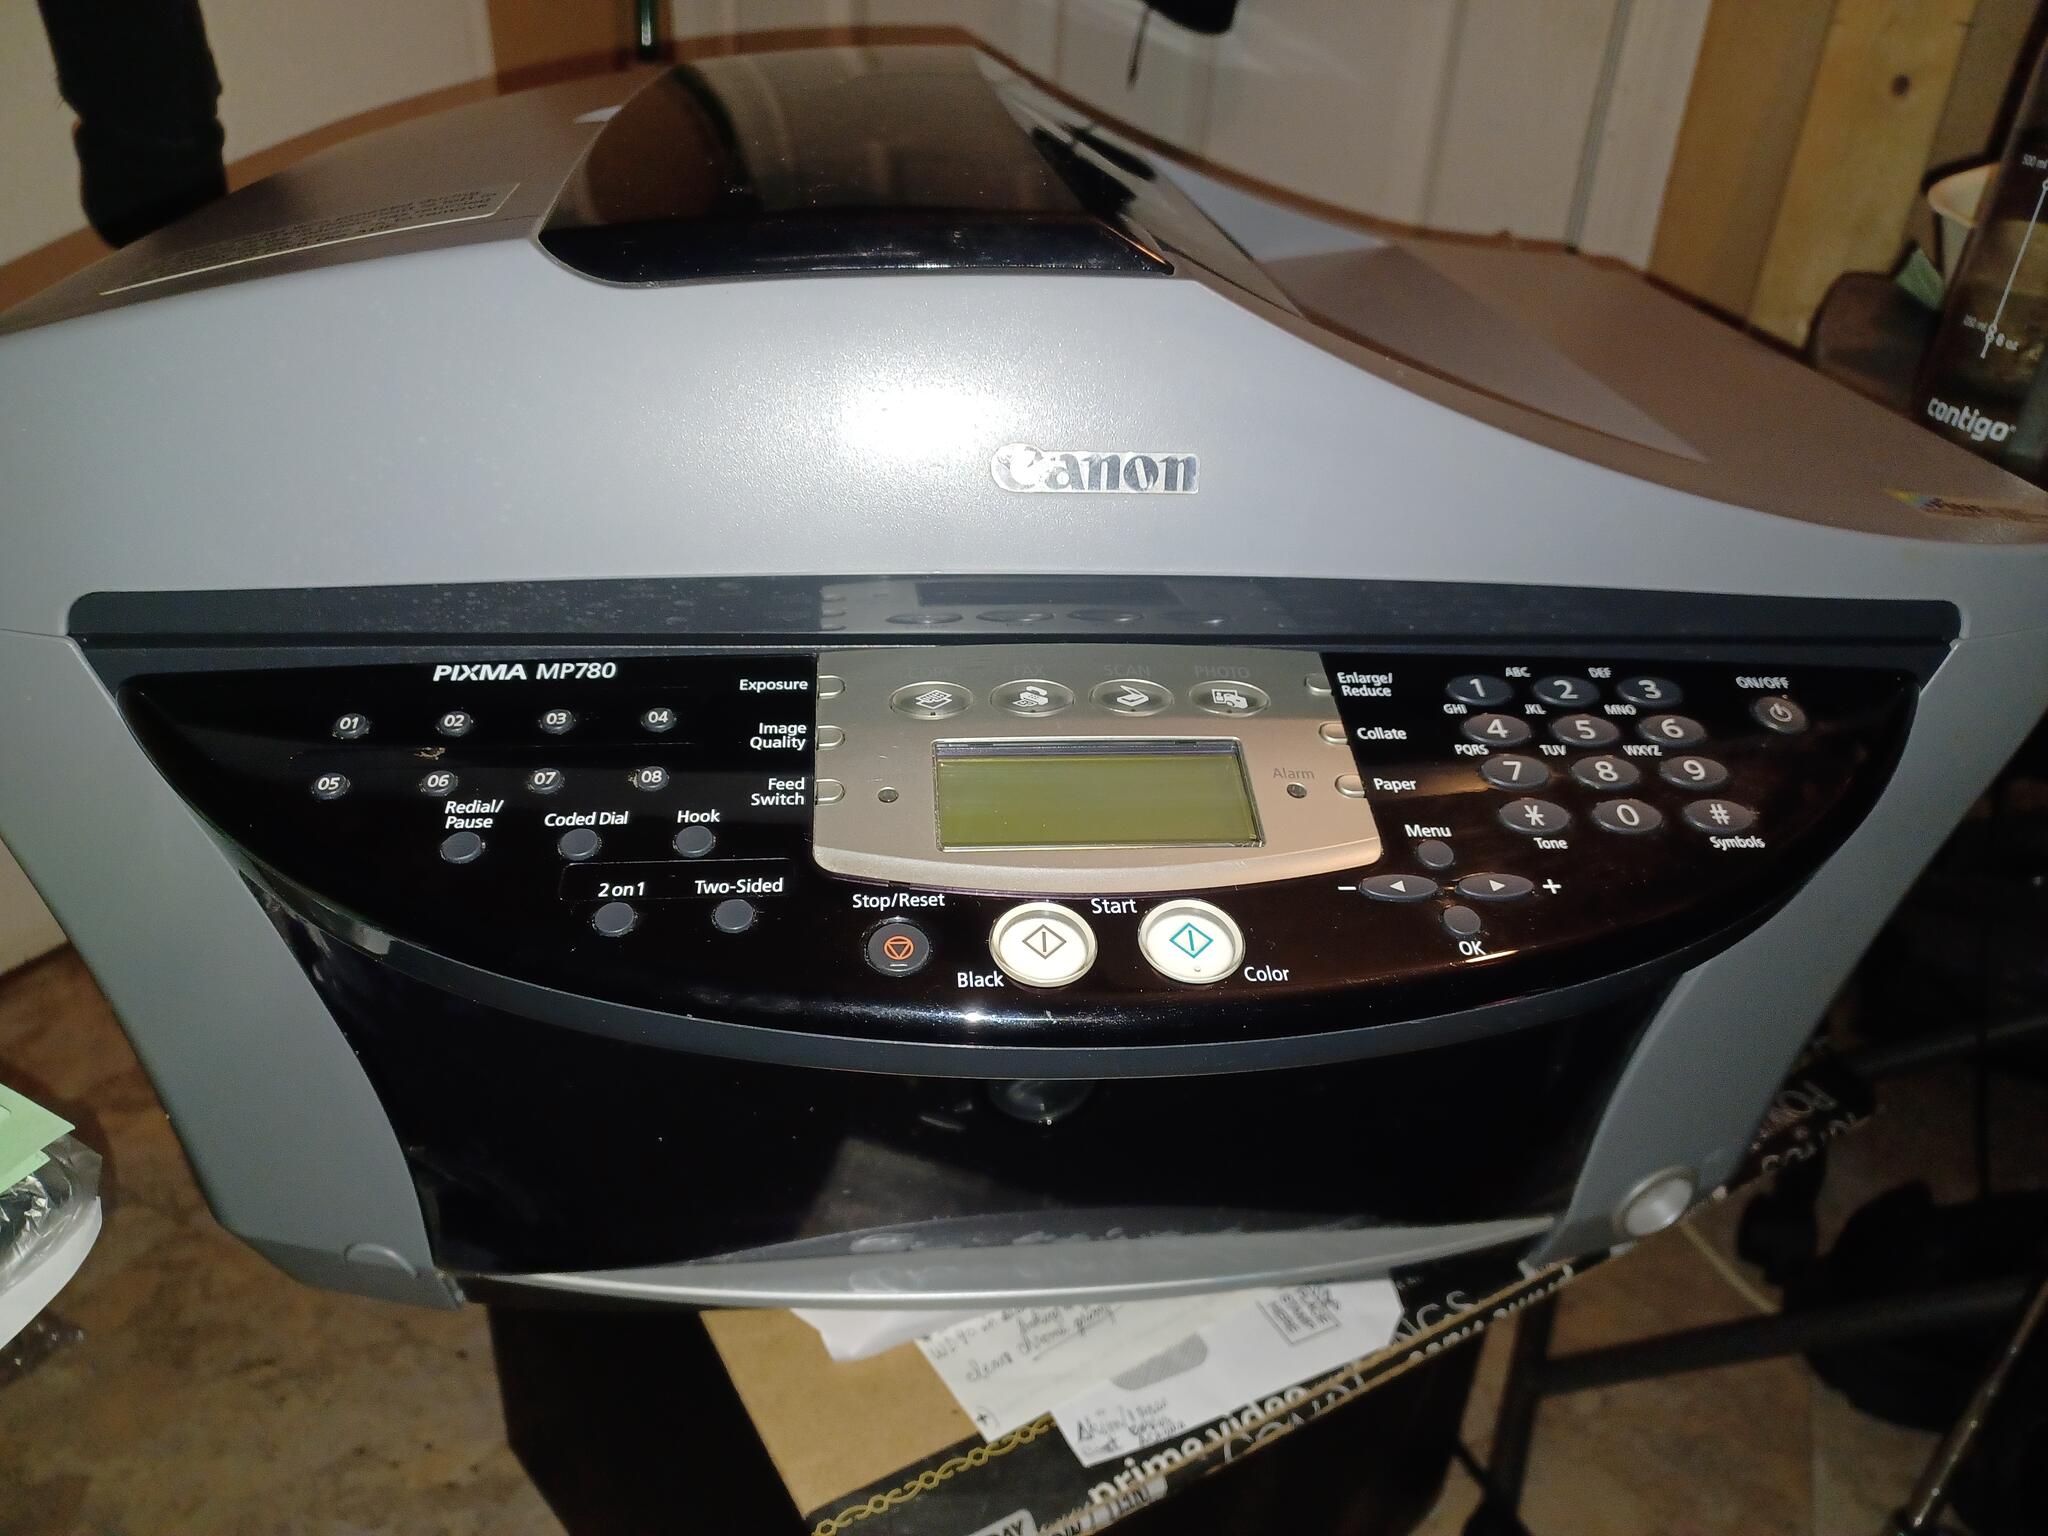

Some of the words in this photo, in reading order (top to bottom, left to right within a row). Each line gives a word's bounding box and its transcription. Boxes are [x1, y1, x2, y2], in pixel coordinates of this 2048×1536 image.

[1928, 398, 2010, 442] contigo
[993, 444, 1199, 493] Canon
[432, 663, 527, 682] PIXMA
[535, 662, 617, 680] MP780
[1014, 664, 1047, 677] FAX
[1103, 664, 1152, 677] SCAN
[1194, 664, 1251, 679] PHOTO
[1336, 671, 1393, 686] Enlarge/
[1505, 666, 1531, 678] ABC
[1588, 667, 1611, 679] DEF
[739, 678, 809, 694] Exposure
[1340, 684, 1392, 697] Reduce
[1469, 678, 1485, 698] 1
[1553, 679, 1578, 700] 2
[1638, 679, 1661, 699] 3
[1735, 675, 1790, 690] ON/OFF
[1443, 703, 1468, 715] GHI
[1603, 704, 1637, 716] MNO
[339, 716, 360, 731] 01
[443, 714, 465, 729] 02
[546, 711, 567, 727] 03
[647, 710, 669, 725] 04
[758, 722, 807, 738] Image
[1356, 726, 1407, 740] Collate
[1486, 718, 1508, 738] 4
[1575, 719, 1596, 739] 5
[1661, 718, 1684, 738] 6
[749, 736, 807, 751] Quality
[1454, 743, 1490, 757] PQRS
[1538, 744, 1567, 756] TUV
[1622, 744, 1663, 757] WXYZ
[640, 770, 663, 785] 08
[1272, 767, 1315, 779] Alarm
[1502, 761, 1522, 781] 7
[1594, 760, 1619, 782] 8
[1683, 759, 1706, 780] 9
[317, 775, 340, 791] 05
[427, 774, 450, 789] 06
[533, 771, 557, 786] 07
[768, 777, 805, 791] Feed
[1373, 777, 1417, 794] Paper
[445, 799, 504, 815] Redial/
[750, 792, 805, 806] Switch
[445, 815, 494, 829] Pause
[544, 811, 597, 827] Coded
[599, 810, 629, 826] Dial
[677, 809, 721, 824] Hook
[1616, 804, 1640, 826] 0
[1404, 823, 1452, 839] Menu
[1533, 837, 1569, 850] Tone
[1709, 835, 1766, 851] Symbols
[598, 883, 610, 897] 2
[614, 885, 634, 897] on
[637, 881, 646, 896] 1
[694, 877, 784, 895] Two-Sided
[852, 892, 946, 910] Stop/Reset
[1090, 897, 1138, 914] Start
[1458, 941, 1486, 957] OK
[957, 970, 1005, 989] Black
[1243, 964, 1290, 982] Color
